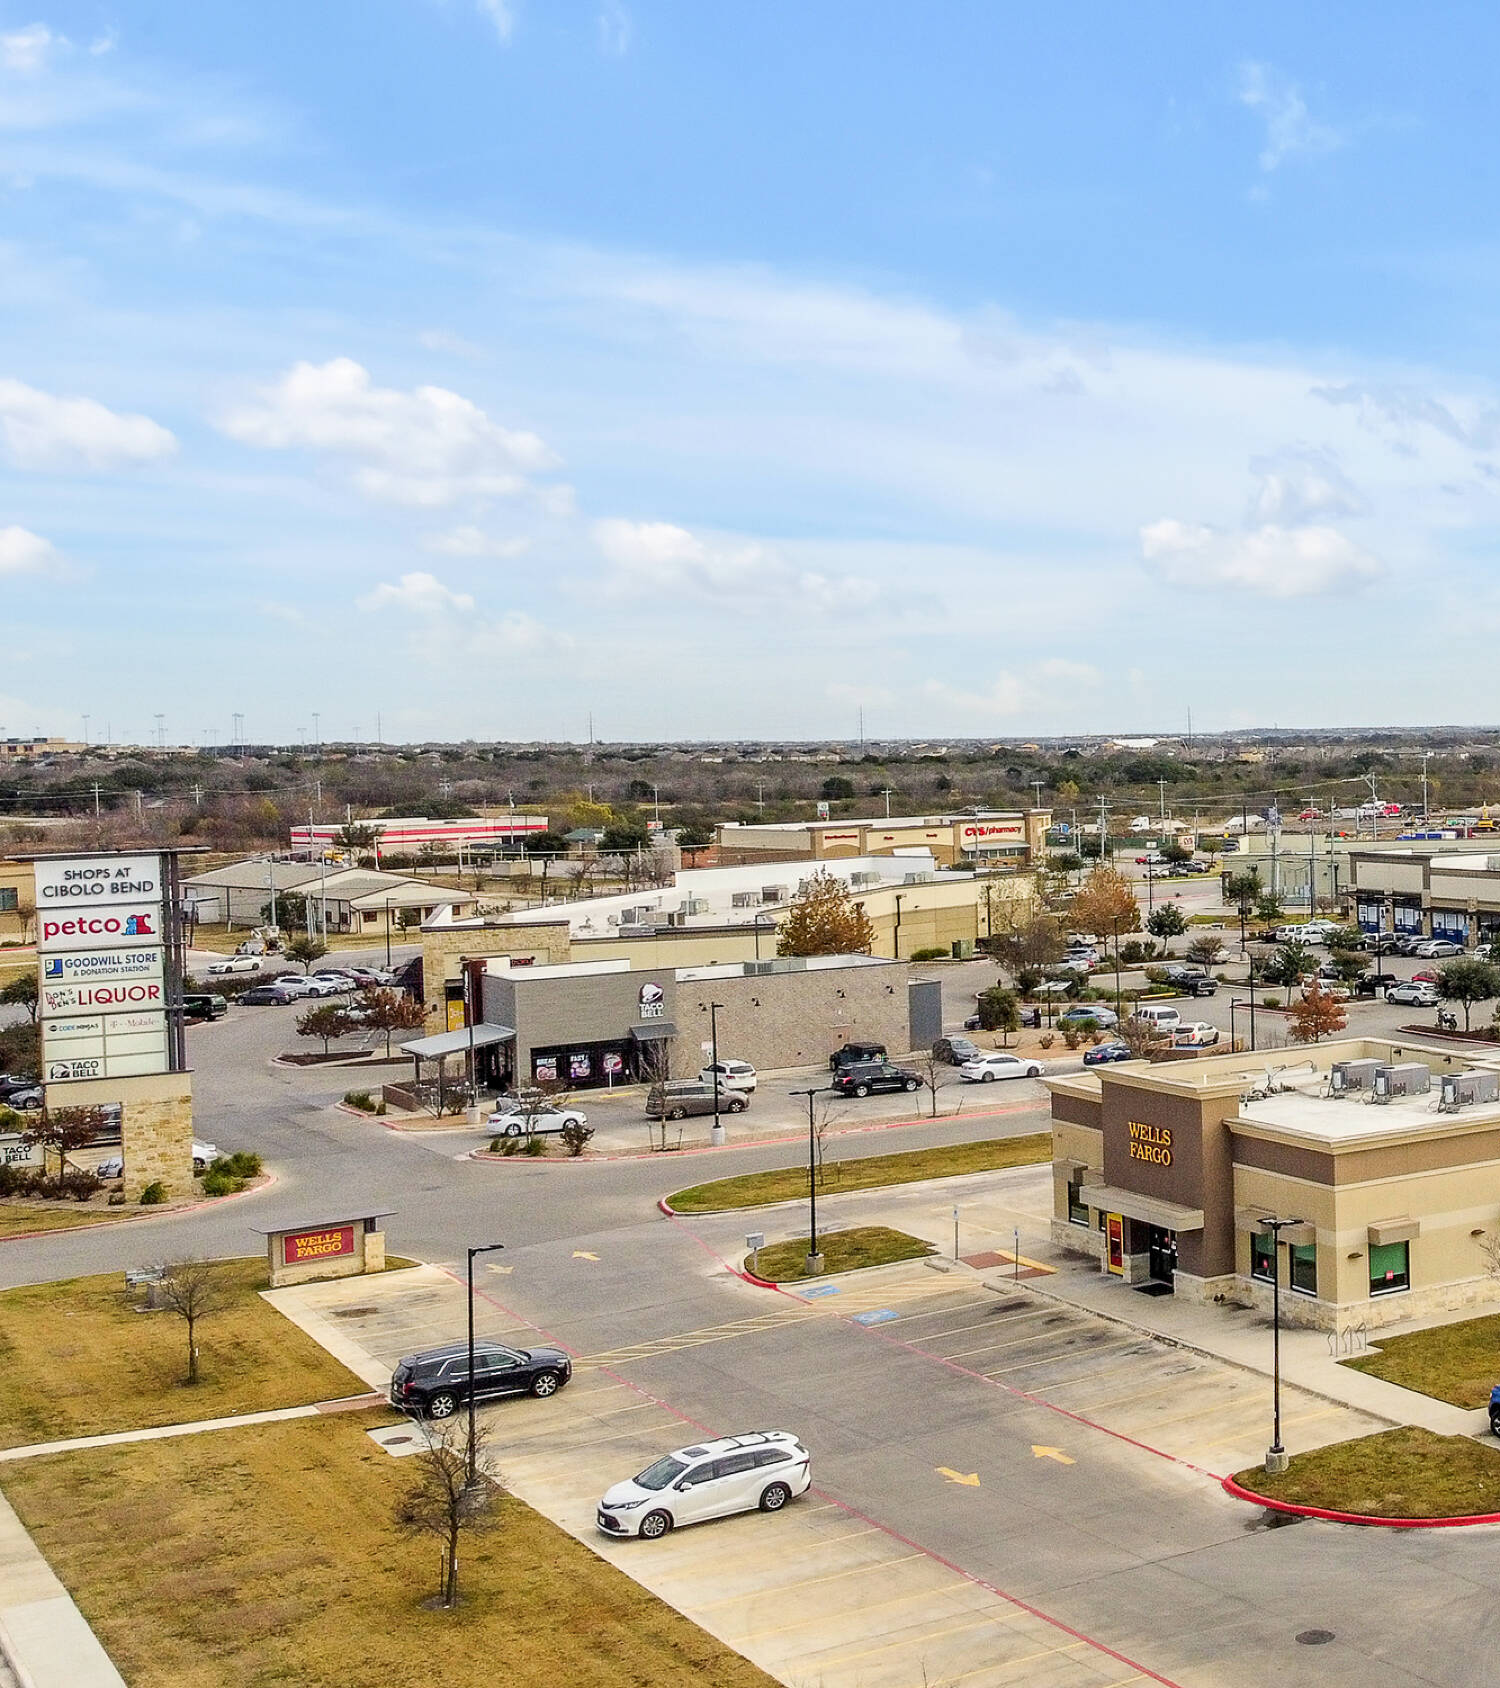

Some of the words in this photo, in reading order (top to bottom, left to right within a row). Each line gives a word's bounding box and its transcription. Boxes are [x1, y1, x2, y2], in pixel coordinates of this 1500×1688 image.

[64, 869, 110, 880] SHOPS
[115, 867, 131, 878] AT
[43, 882, 104, 897] CIBOLO
[110, 881, 154, 893] BEND
[44, 917, 121, 941] petco
[64, 955, 123, 969] GOODWILL
[125, 953, 157, 964] STORE
[80, 967, 119, 976] DONATION
[79, 985, 160, 1006] LIQUOR
[641, 1009, 664, 1018] BELL
[70, 1061, 99, 1069] TACO
[72, 1069, 99, 1078] BELL
[1128, 1121, 1171, 1146] WELLS
[3, 1145, 31, 1154] TACO
[1129, 1141, 1171, 1166] FARGO
[296, 1232, 342, 1248] WELLS
[297, 1242, 342, 1257] FARGO
